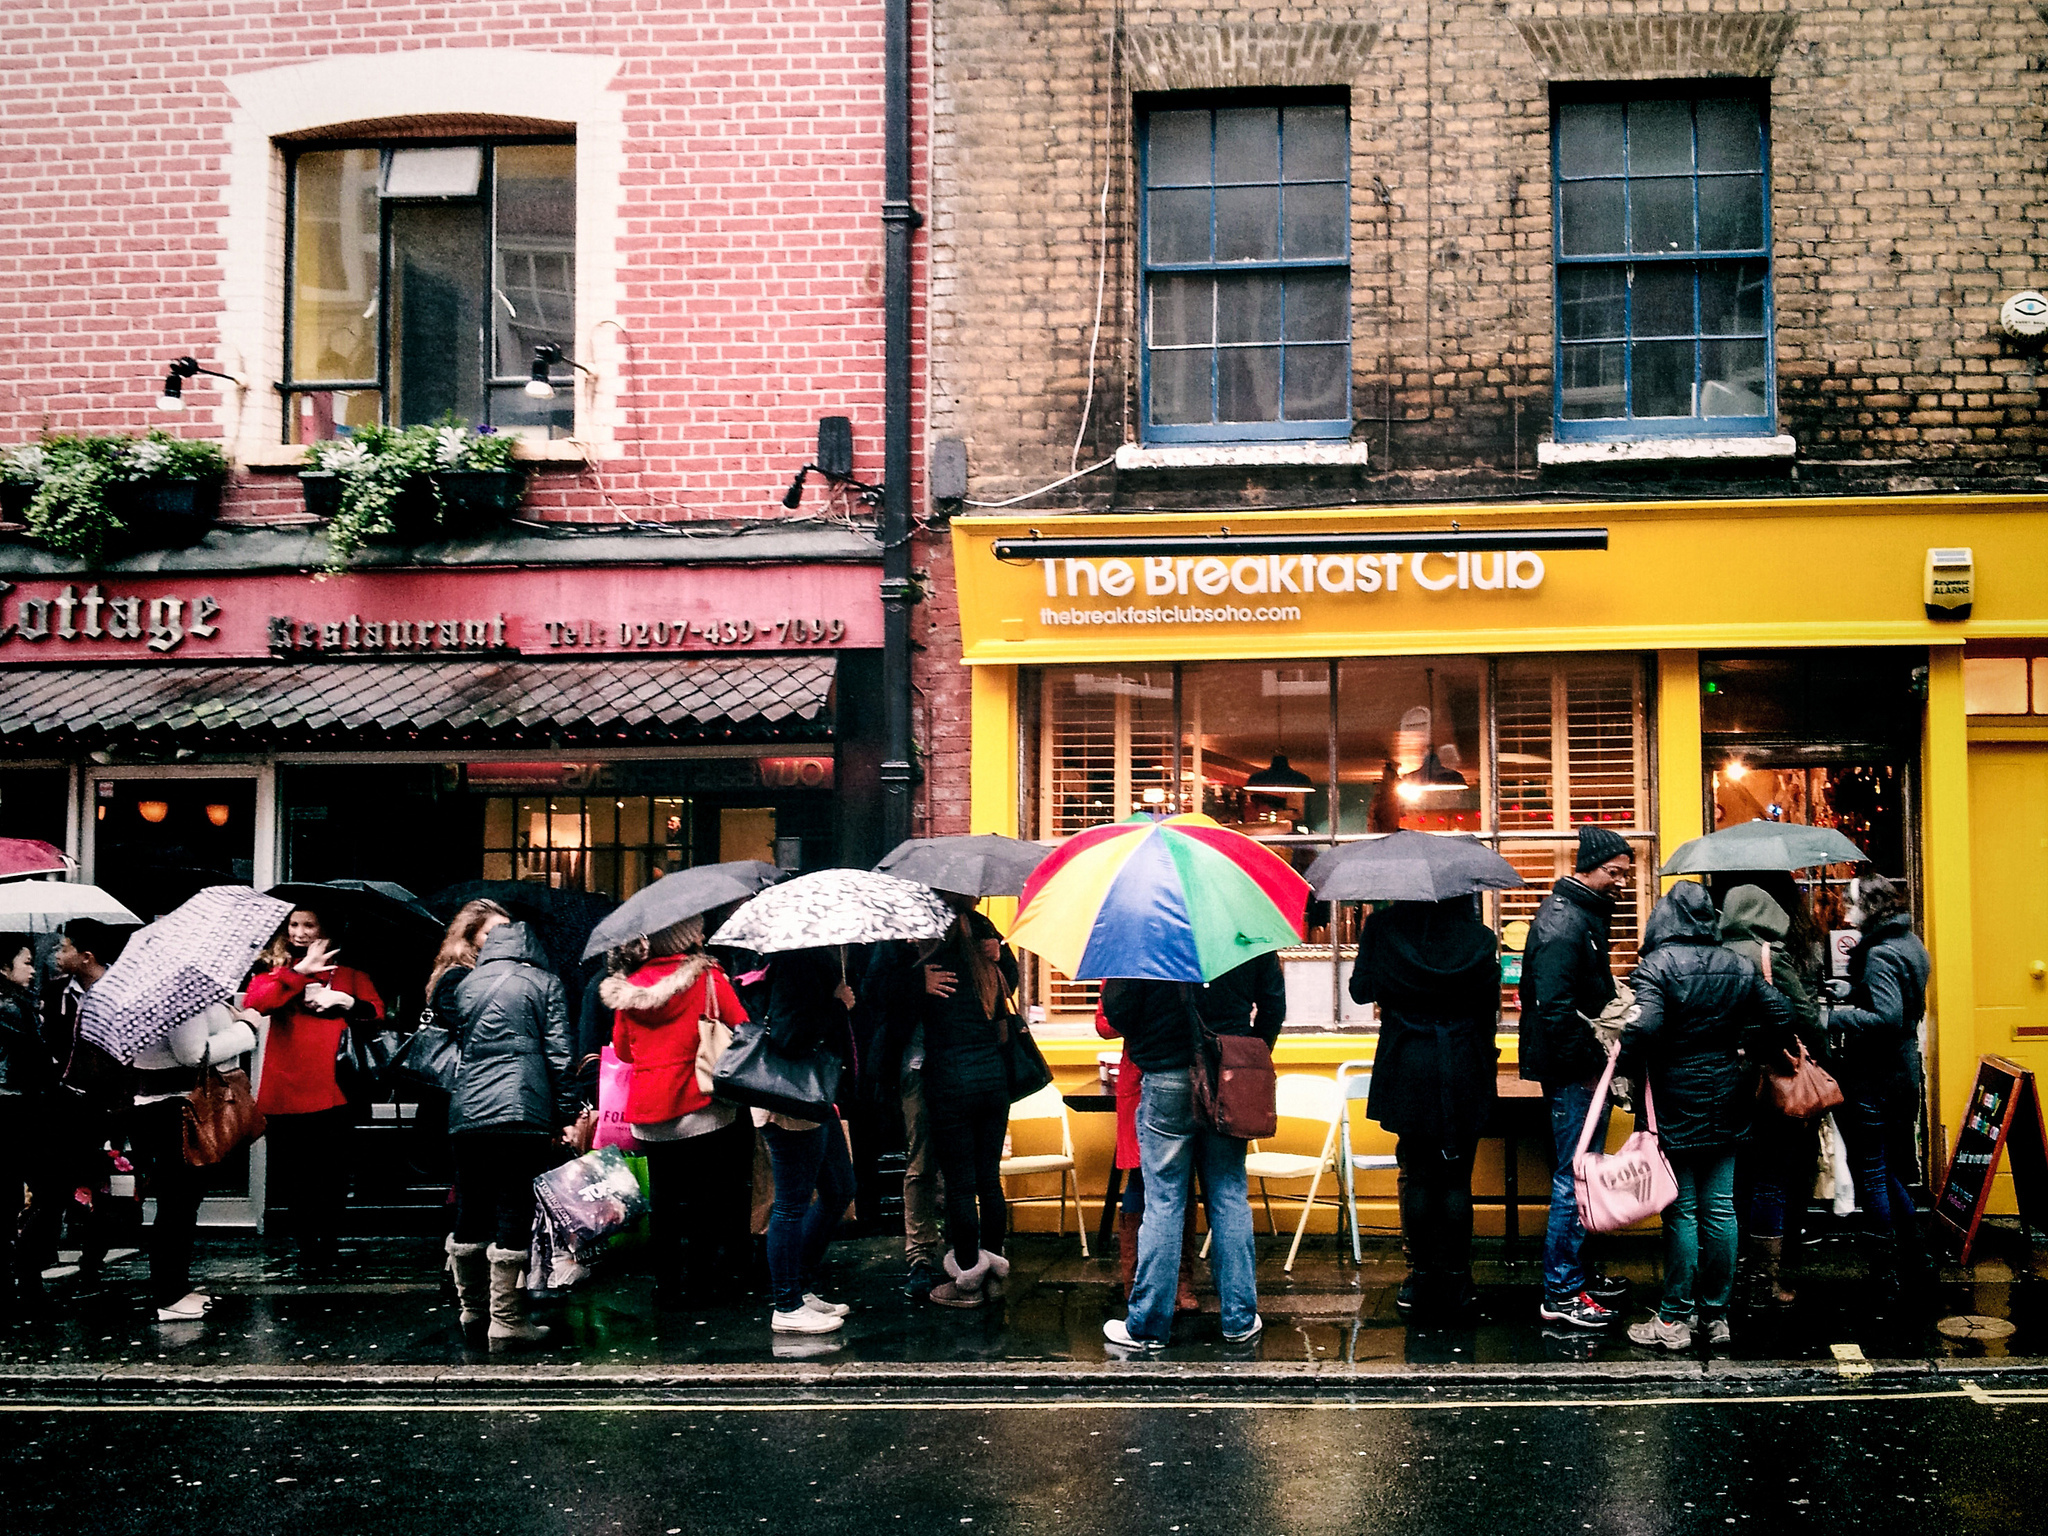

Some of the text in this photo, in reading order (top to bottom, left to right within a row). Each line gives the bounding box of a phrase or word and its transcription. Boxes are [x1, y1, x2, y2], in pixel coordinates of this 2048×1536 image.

[1036, 551, 1546, 597] The Breakfast Club
[1933, 586, 1970, 595] ALARMS
[0, 580, 221, 652] ottage
[268, 612, 507, 650] Restaurant
[1040, 604, 1301, 625] thebreakfastclubsoho.com
[1599, 1161, 1651, 1191] Gola
